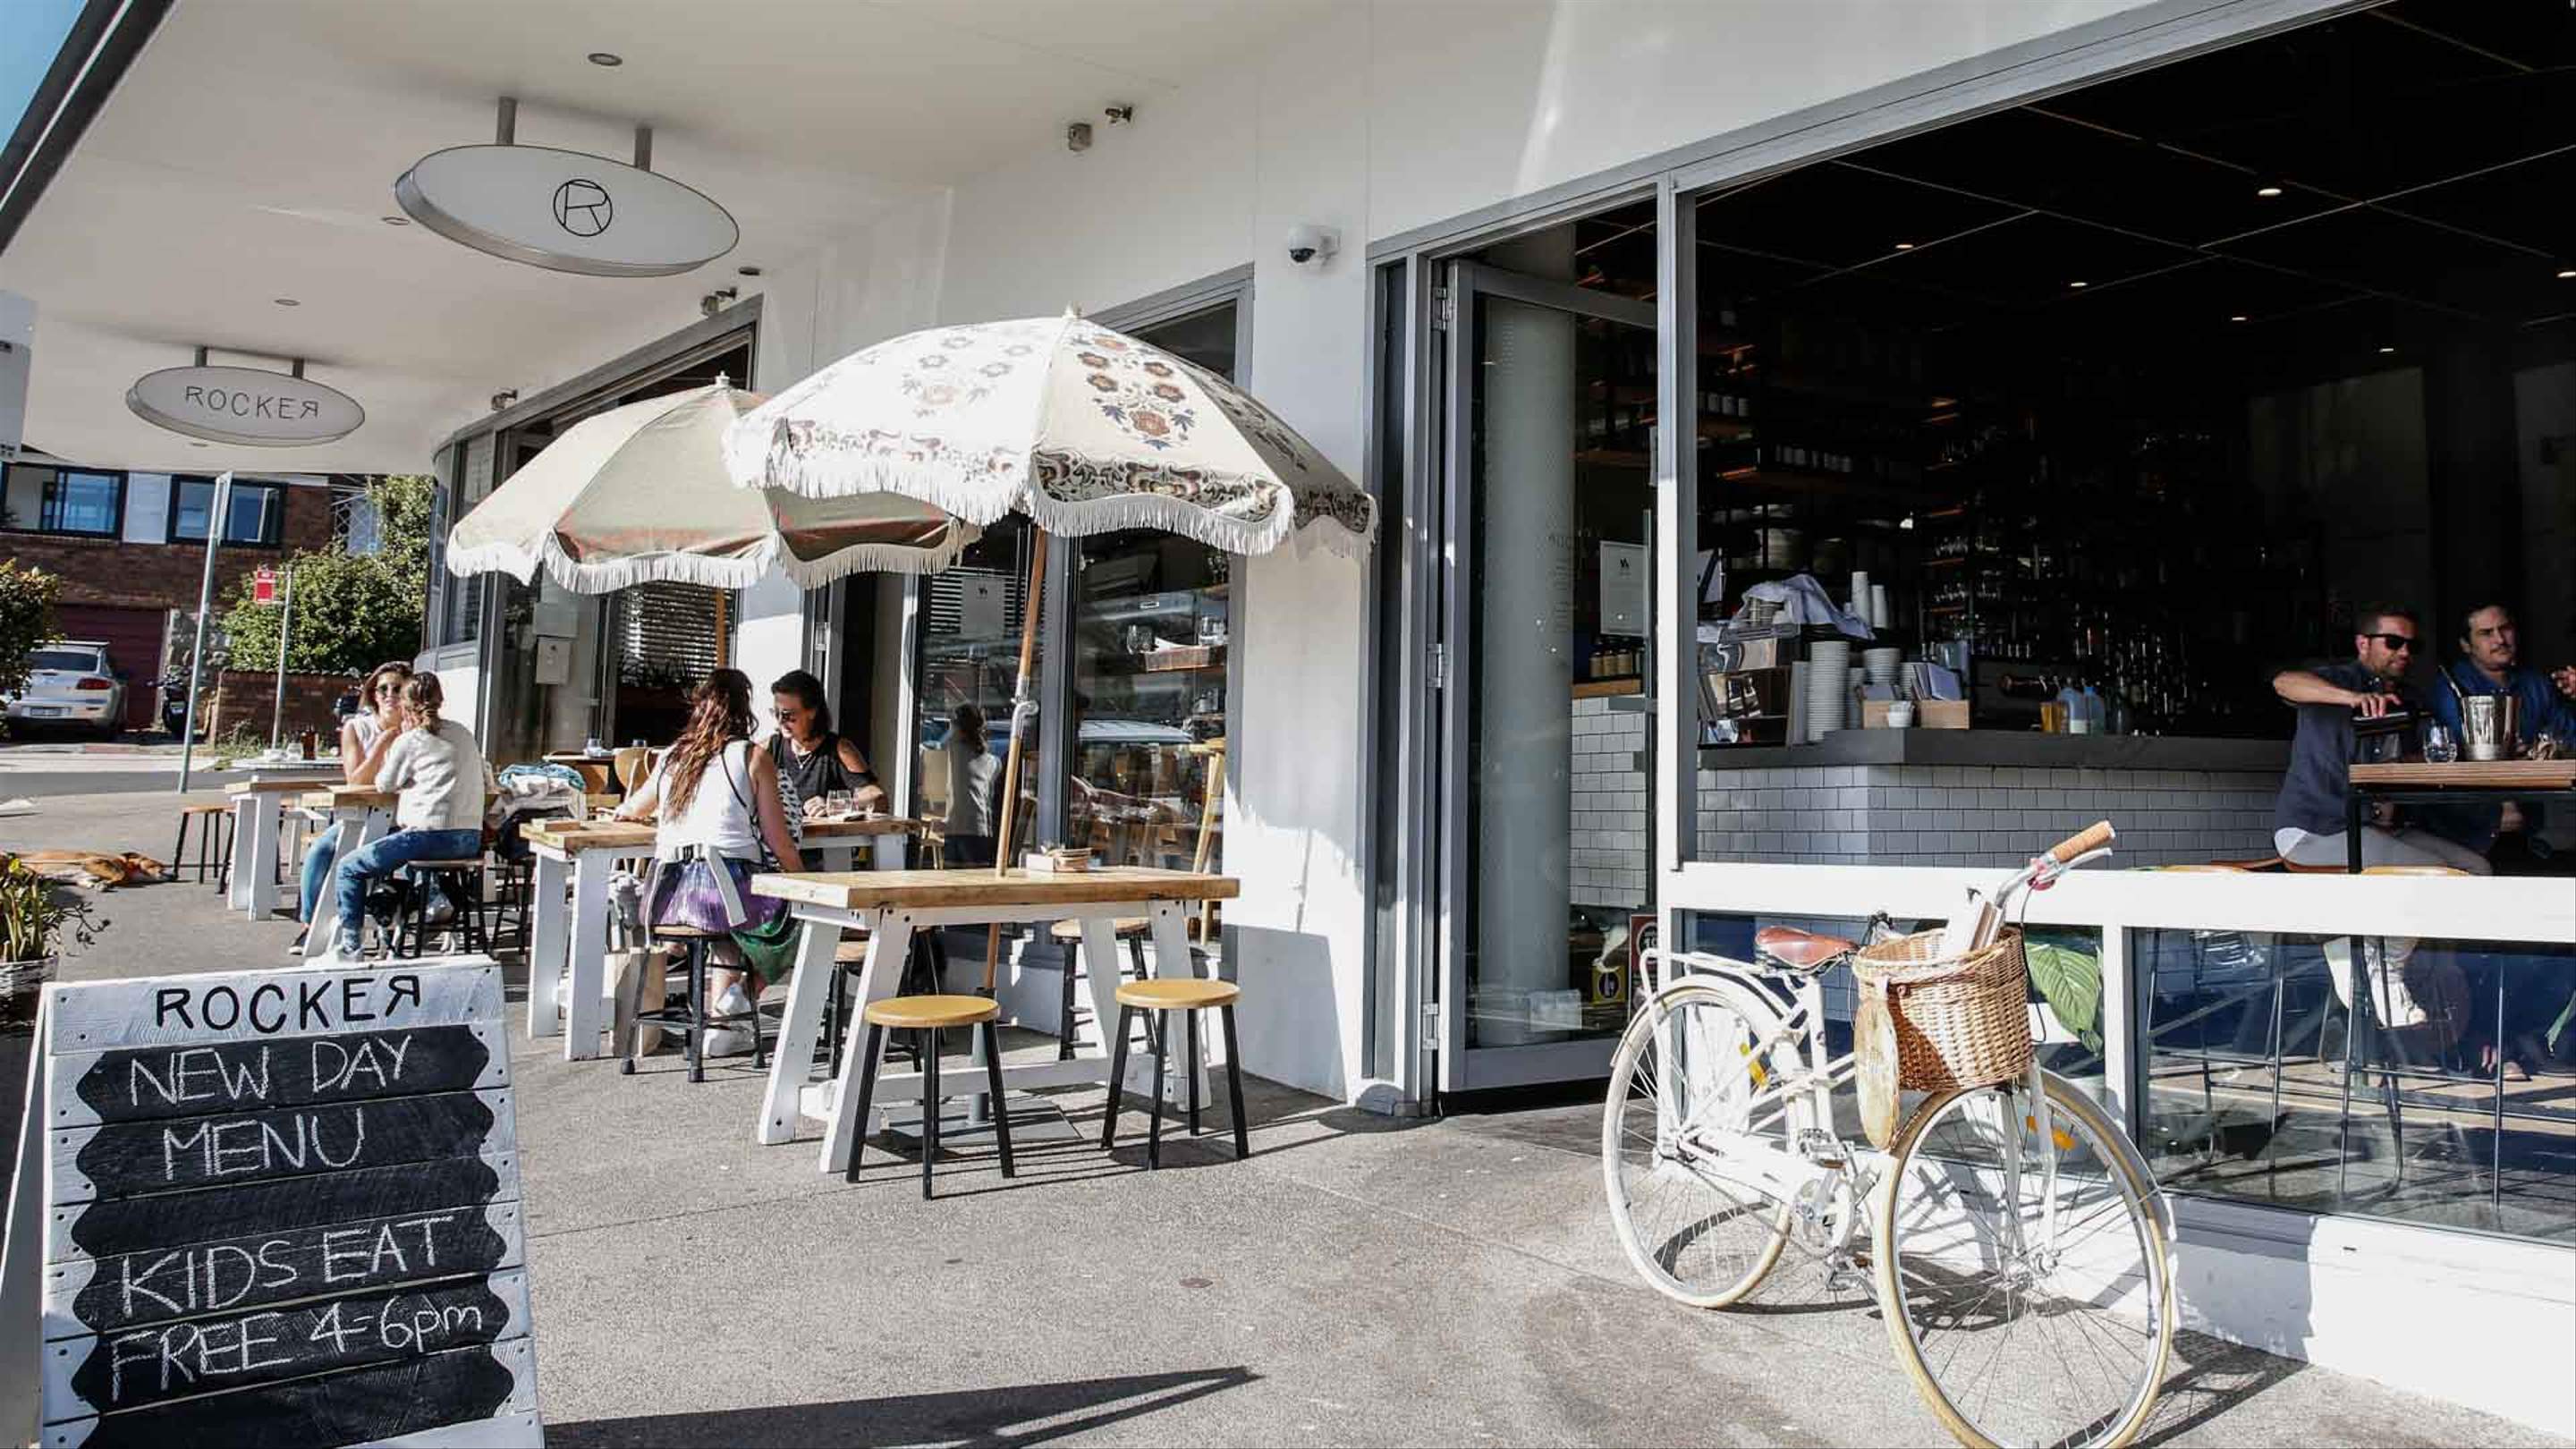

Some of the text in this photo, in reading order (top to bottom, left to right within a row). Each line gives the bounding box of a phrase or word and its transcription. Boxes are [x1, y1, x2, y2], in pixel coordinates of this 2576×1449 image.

[130, 1034, 412, 1107] NEW DAY
[163, 1106, 366, 1182] MENU
[120, 1216, 453, 1318] KIDS EAT
[110, 1311, 293, 1402] FREE
